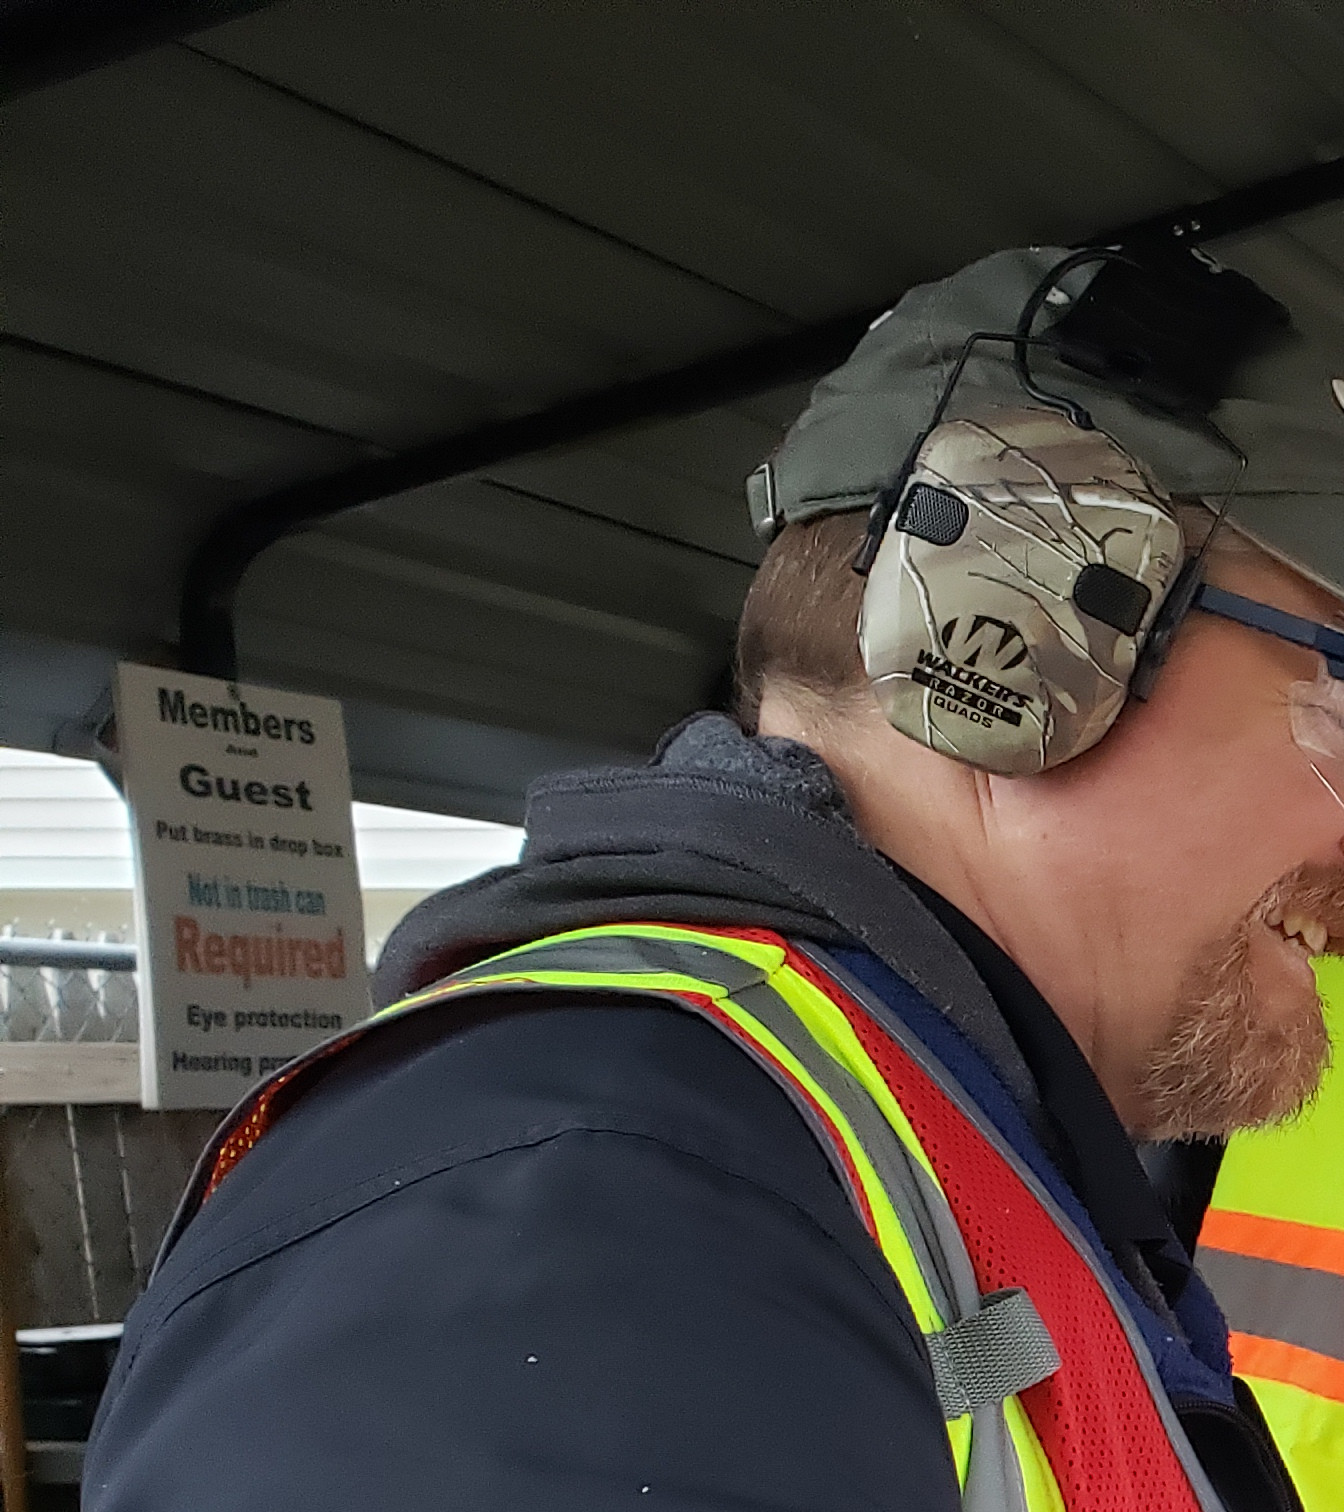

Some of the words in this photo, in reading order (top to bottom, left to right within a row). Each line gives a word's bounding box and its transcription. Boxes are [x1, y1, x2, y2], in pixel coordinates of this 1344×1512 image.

[158, 686, 316, 745] Members
[929, 677, 1004, 718] RAZOR
[933, 695, 993, 729] QUADS
[179, 762, 313, 812] Guest
[156, 819, 188, 842] Put
[248, 830, 265, 850] in
[269, 835, 308, 857] drop
[173, 914, 348, 985] Required
[186, 1004, 228, 1032] Eye
[234, 1010, 343, 1033] protection
[172, 1051, 252, 1077] Hearing
